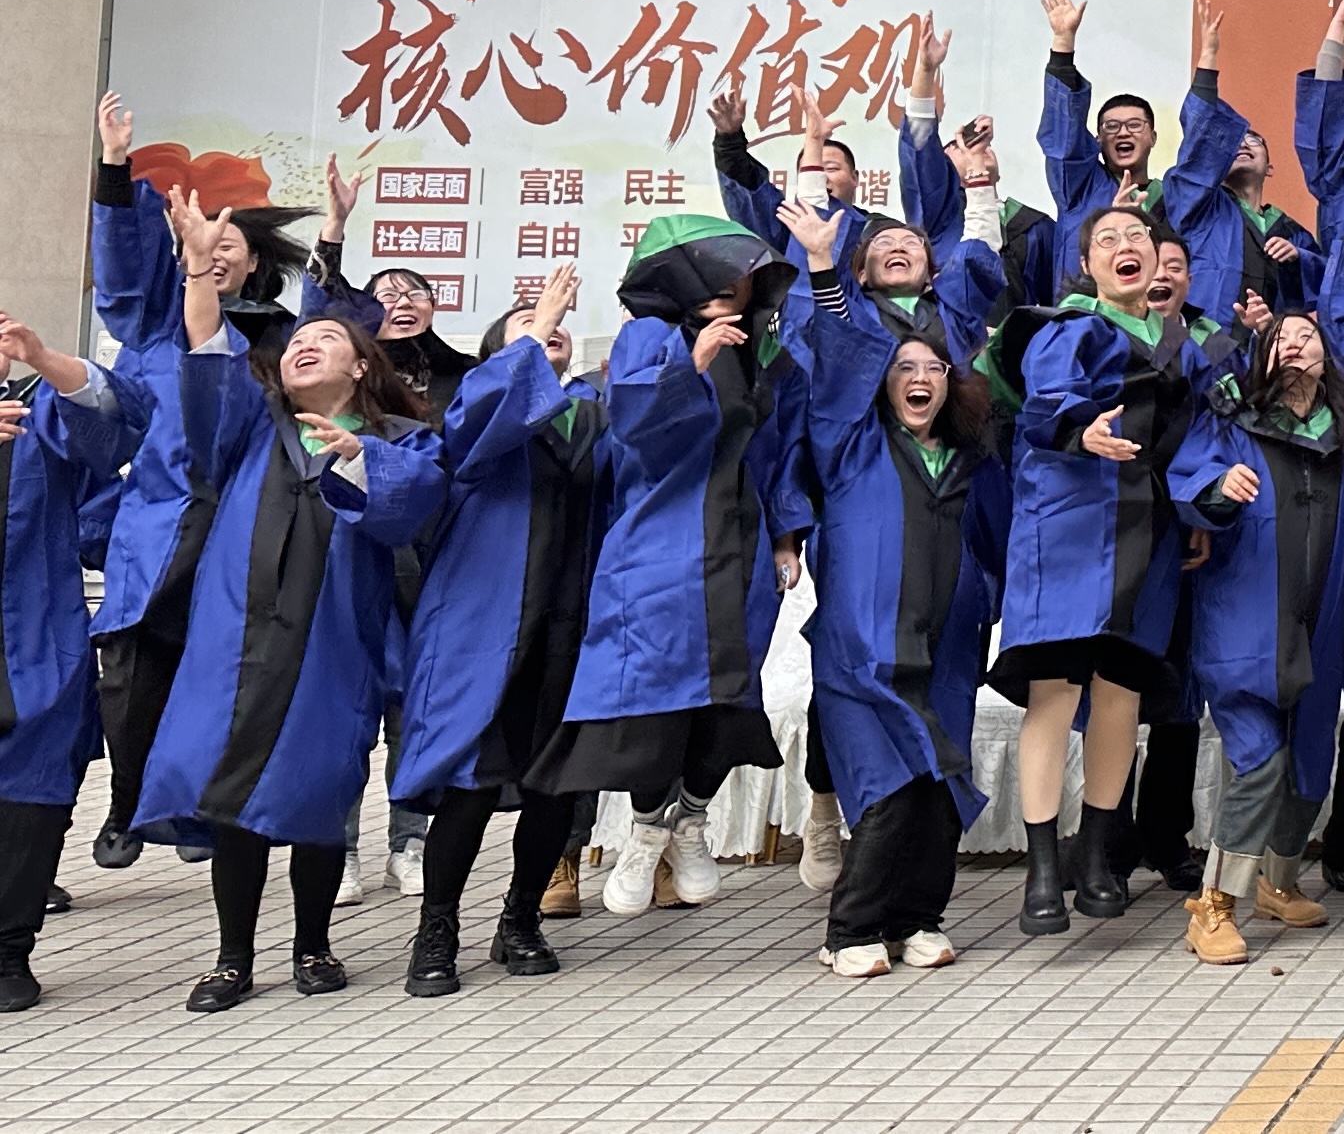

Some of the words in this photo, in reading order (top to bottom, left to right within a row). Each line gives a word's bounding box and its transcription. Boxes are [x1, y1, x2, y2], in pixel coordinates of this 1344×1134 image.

[380, 173, 467, 199] 国家层面
[520, 168, 584, 205] 富强
[624, 168, 686, 205] 民主
[376, 226, 463, 253] 社会层面
[517, 221, 581, 258] 自由
